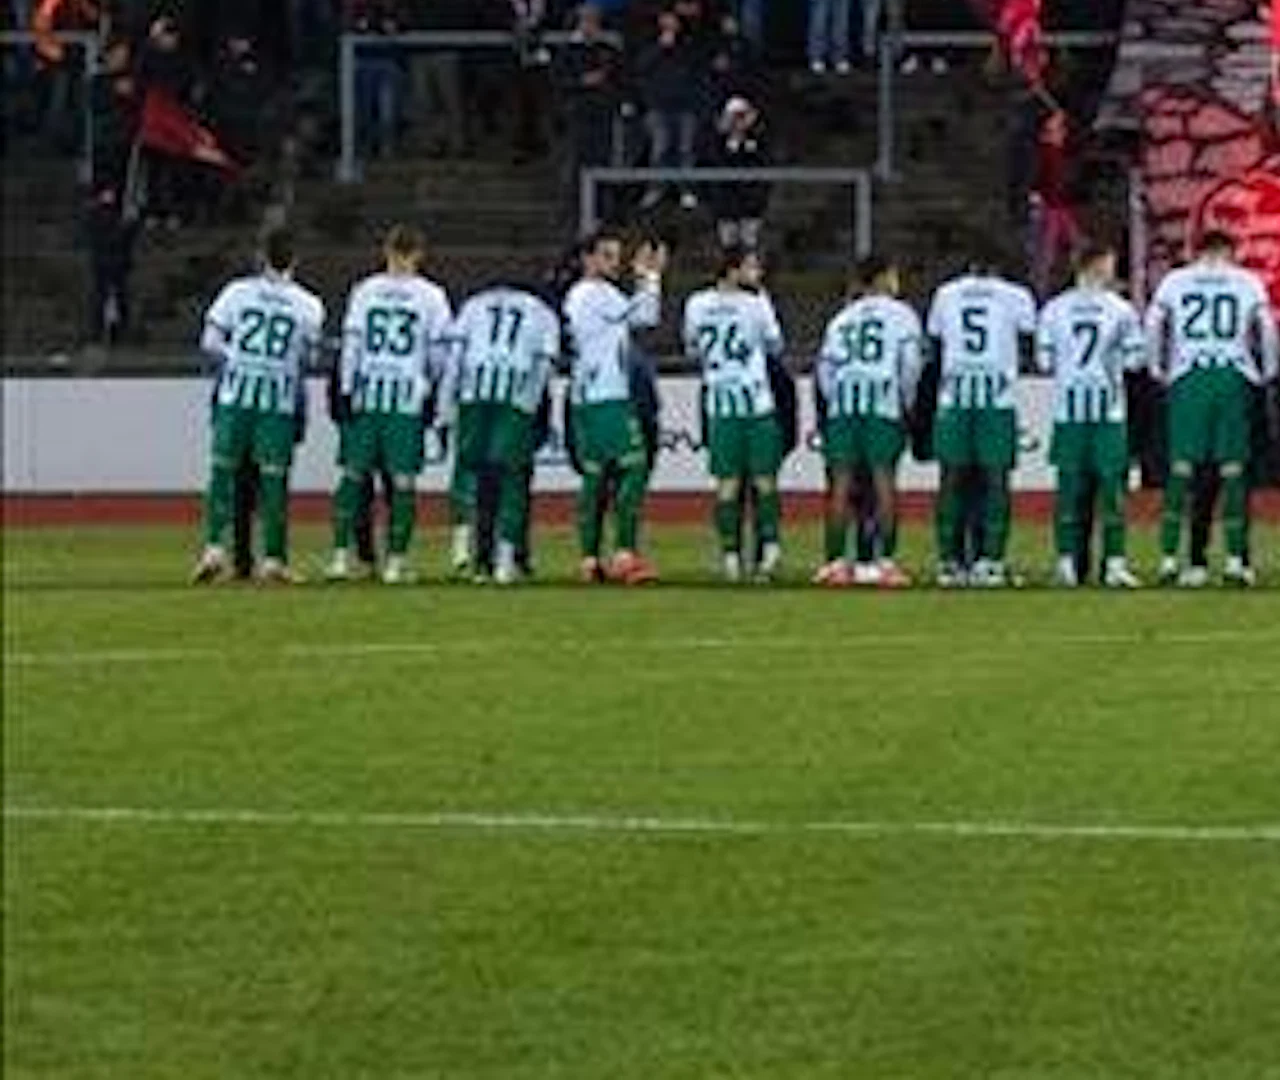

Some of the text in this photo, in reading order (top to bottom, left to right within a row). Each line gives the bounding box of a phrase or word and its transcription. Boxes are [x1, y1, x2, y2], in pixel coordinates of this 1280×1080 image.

[240, 308, 296, 358] 28
[367, 307, 418, 356] 63
[488, 305, 522, 346] 11
[962, 307, 989, 353] 5
[1180, 293, 1240, 340] 20
[838, 319, 884, 362] 36
[1072, 322, 1099, 367] 7
